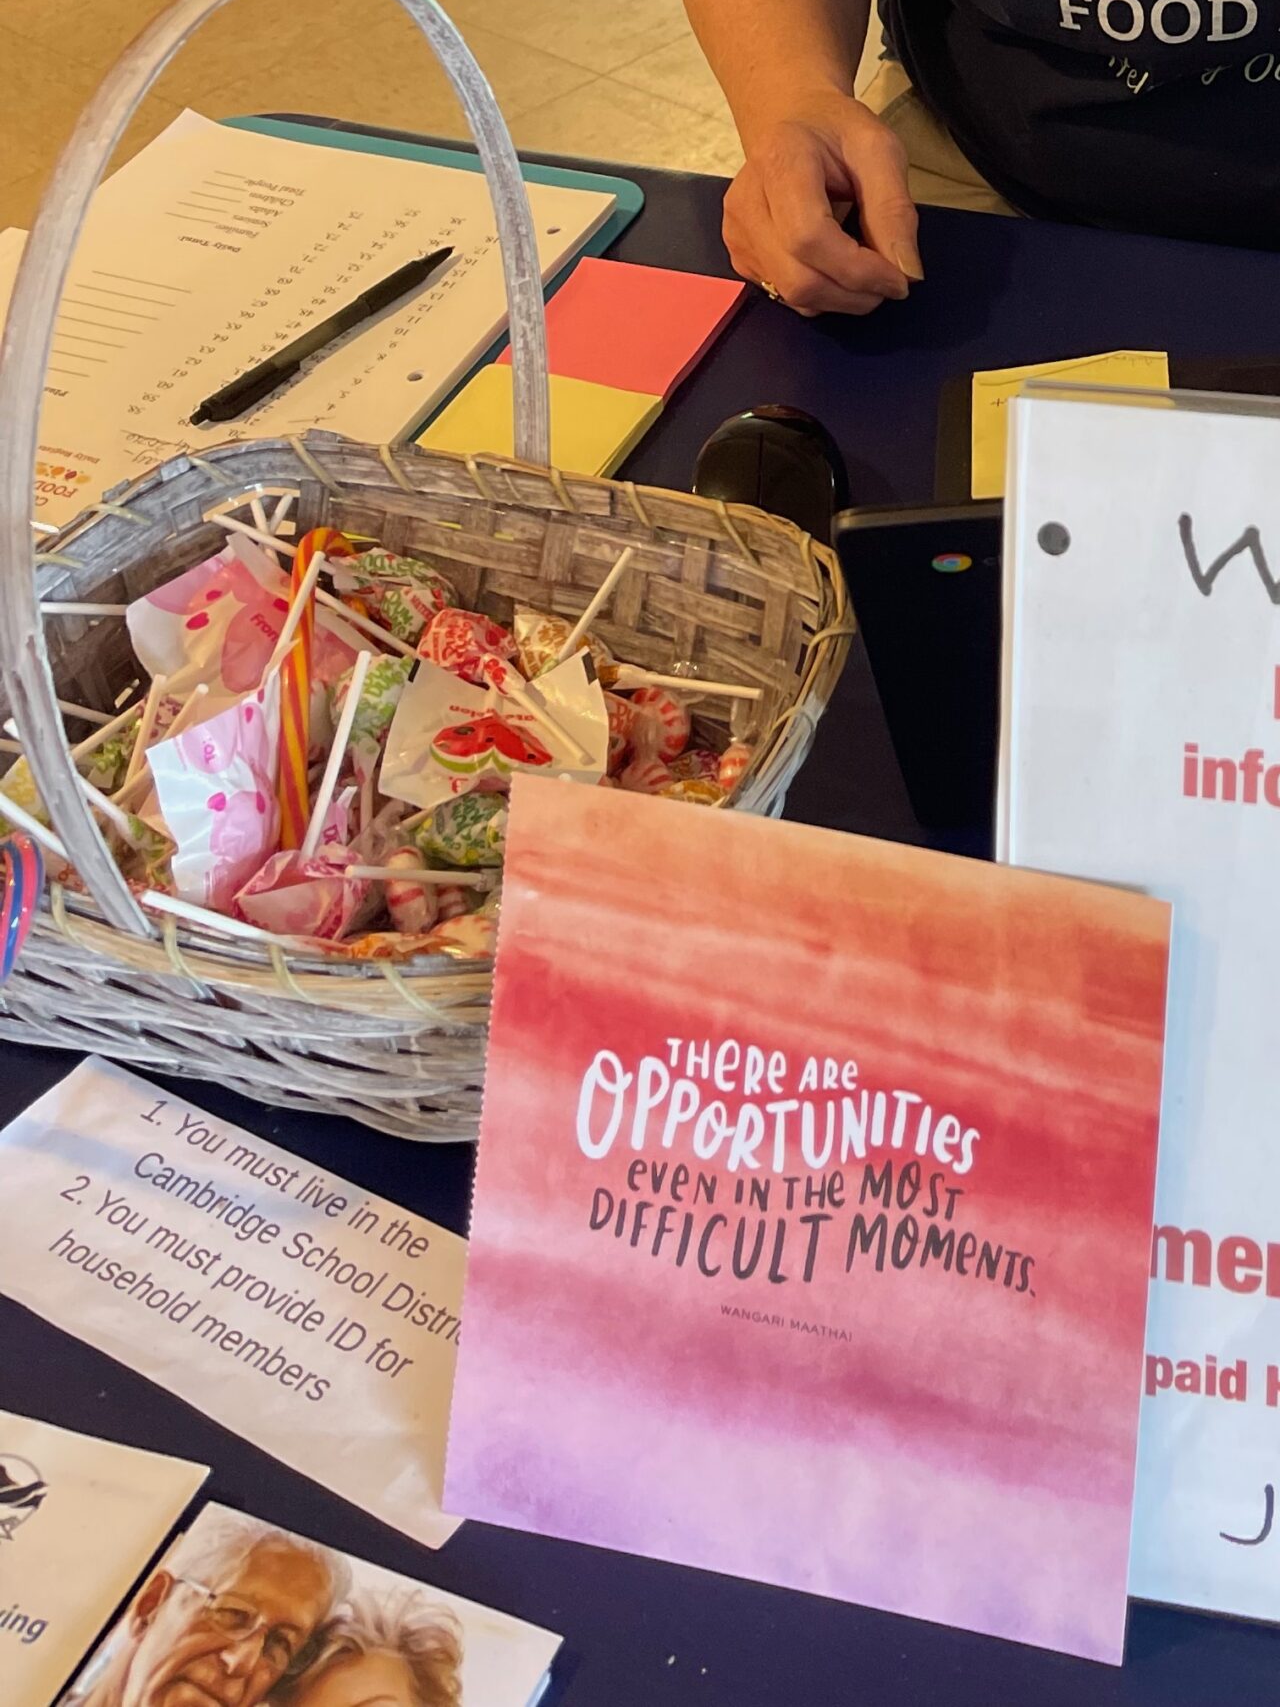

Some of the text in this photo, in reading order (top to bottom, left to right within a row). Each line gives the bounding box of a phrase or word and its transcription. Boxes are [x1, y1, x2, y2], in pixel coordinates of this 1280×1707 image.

[133, 1151, 280, 1251] Cambridge
[282, 1230, 381, 1300] School
[139, 1097, 431, 1260] 1. You must live in the
[590, 1187, 835, 1285] DIFFICULT
[734, 1177, 771, 1212] IN
[859, 1160, 964, 1220] MOST
[48, 1228, 333, 1402] household members
[60, 1174, 416, 1381] 2. You must provide ID for
[721, 1304, 853, 1343] WANGARI MAATHAI
[1144, 1353, 1248, 1403] paid
